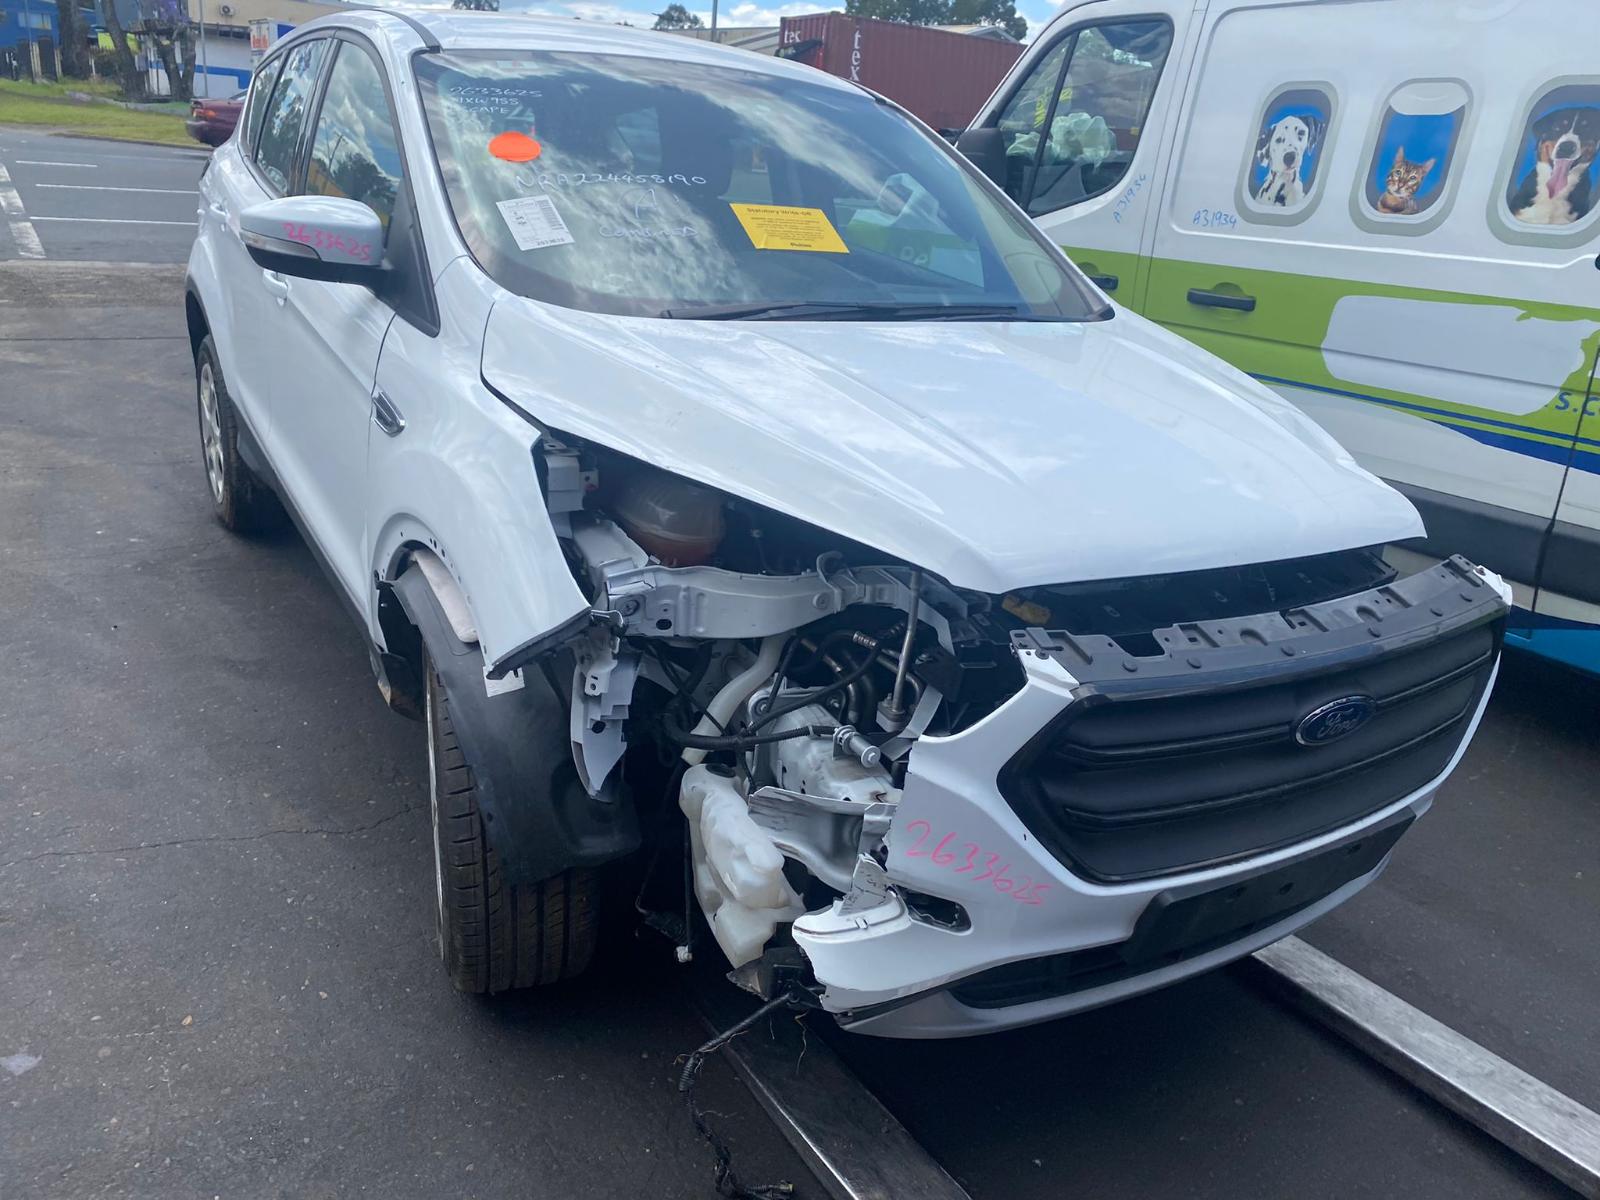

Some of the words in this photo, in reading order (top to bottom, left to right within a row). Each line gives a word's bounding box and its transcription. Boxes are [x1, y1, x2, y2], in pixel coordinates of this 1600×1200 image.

[1192, 209, 1237, 228] A31934
[283, 222, 372, 261] 2633625
[1317, 708, 1361, 738] Ford
[906, 819, 1055, 906] 2633625
